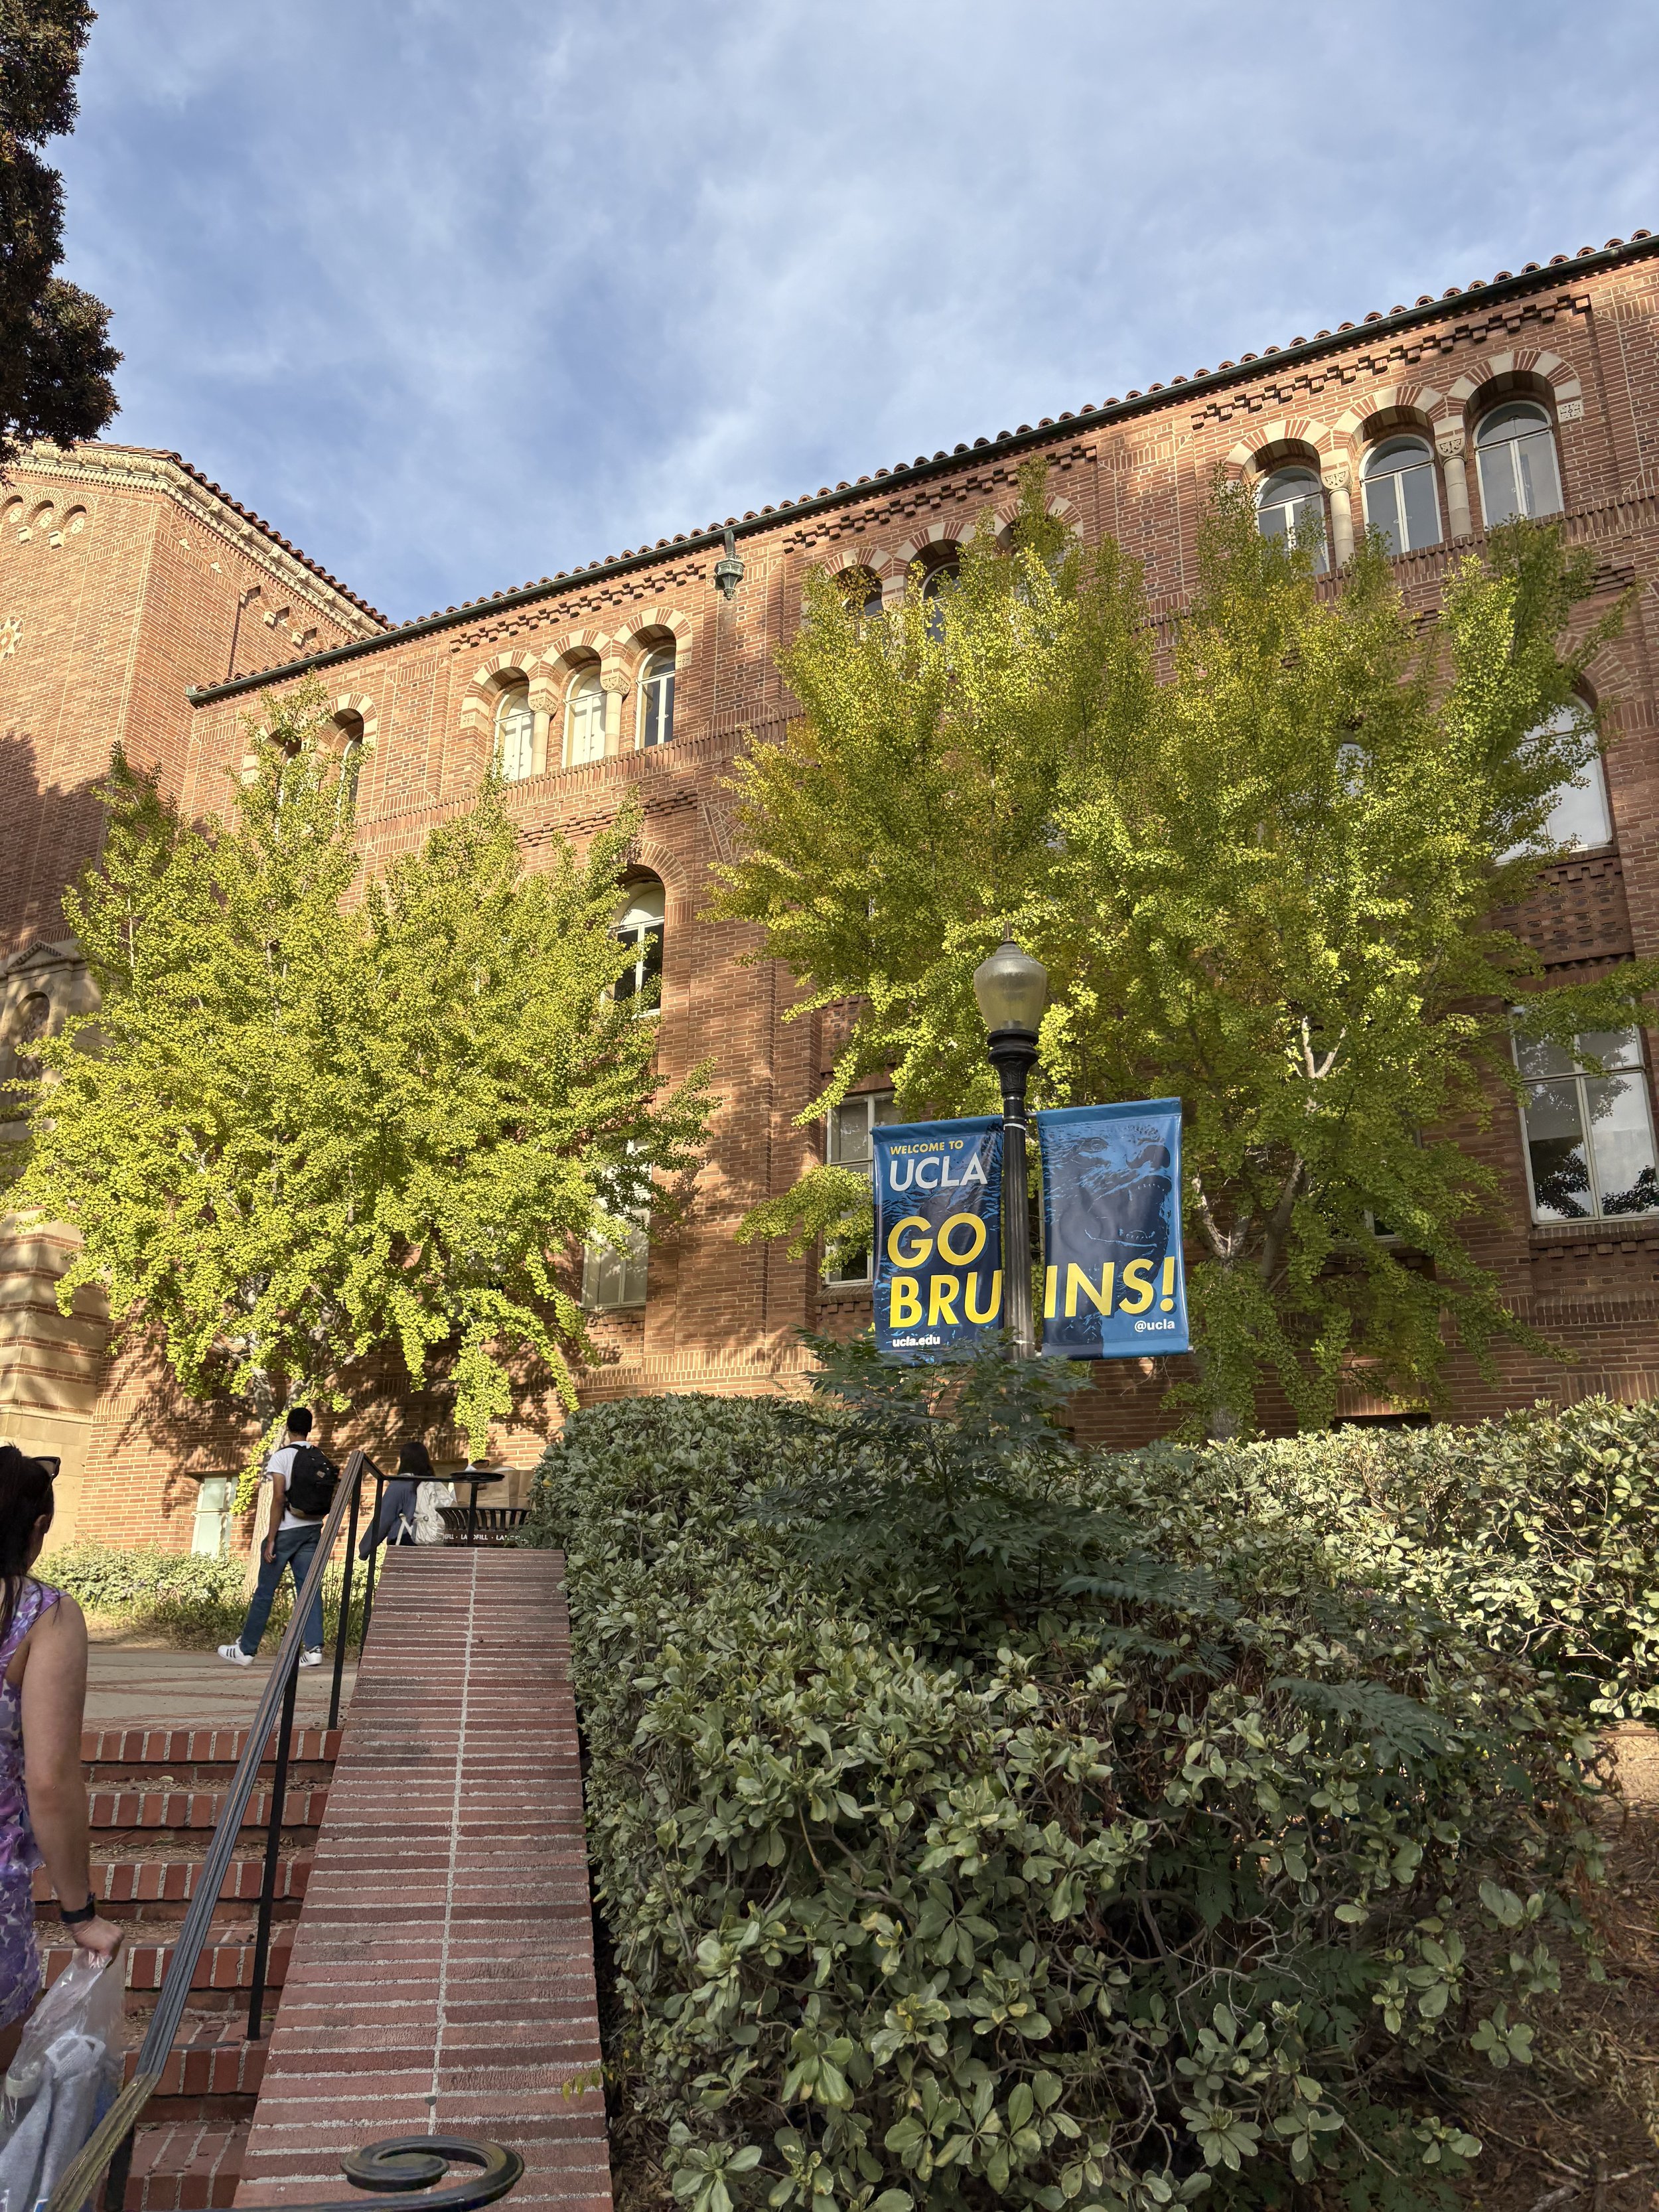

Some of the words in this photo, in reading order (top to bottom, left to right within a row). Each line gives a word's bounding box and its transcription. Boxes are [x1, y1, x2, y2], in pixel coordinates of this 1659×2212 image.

[890, 1142, 945, 1155] WELCOME
[948, 1140, 964, 1150] TO
[889, 1151, 988, 1191] UCLA
[887, 1212, 987, 1268] GO
[889, 1269, 1003, 1328] BRU
[1043, 1256, 1175, 1319] INS!
[892, 1334, 941, 1347] ucla.edu
[1134, 1318, 1175, 1333] @ucla
